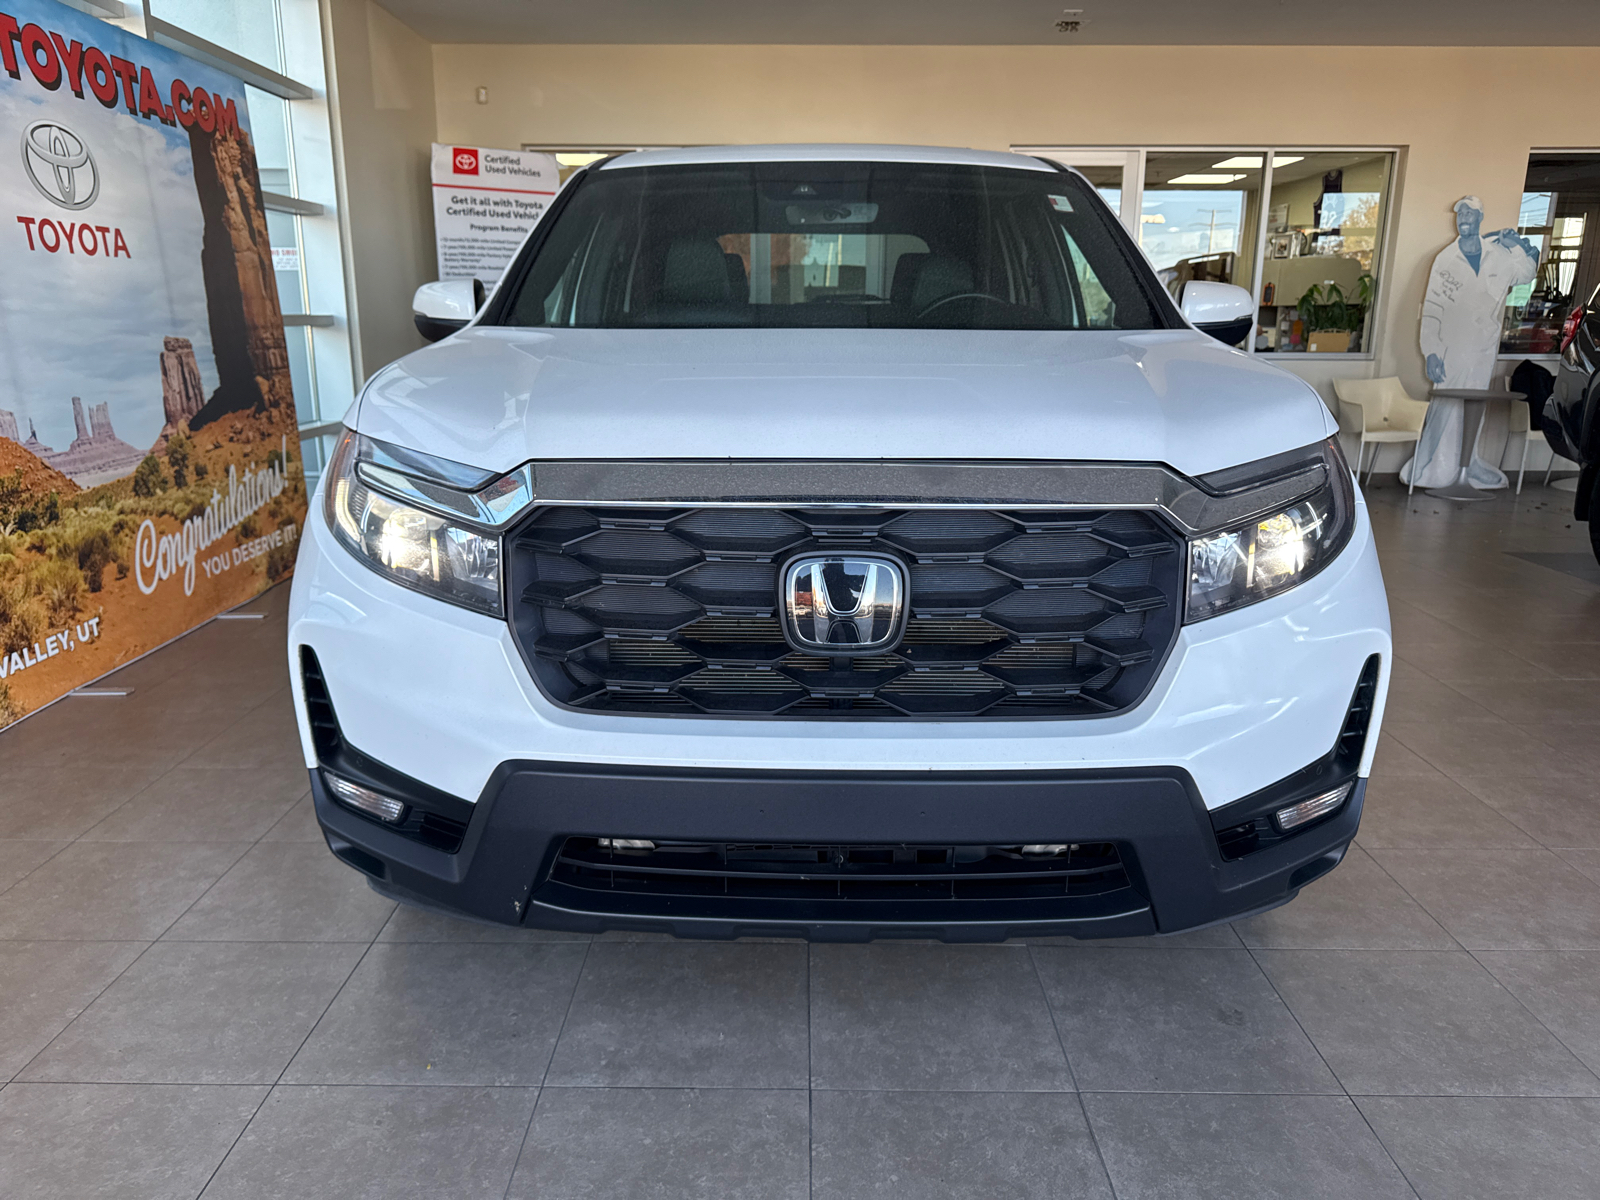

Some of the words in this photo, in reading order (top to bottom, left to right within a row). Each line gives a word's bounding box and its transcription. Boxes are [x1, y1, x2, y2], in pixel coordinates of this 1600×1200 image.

[0, 12, 241, 141] TOYOTA.COM
[484, 154, 521, 166] Certified
[485, 165, 507, 175] Used
[508, 167, 541, 178] Vehicles
[446, 206, 488, 218] Certified
[489, 208, 512, 219] Used
[451, 195, 468, 206] Get
[470, 196, 478, 206] it
[479, 198, 491, 207] all
[492, 198, 513, 208] with
[514, 200, 544, 211] Toyota
[16, 216, 131, 259] TOYOTA
[470, 223, 499, 233] Program
[501, 224, 529, 234] Benefits
[135, 434, 288, 597] Congratulations!
[202, 551, 231, 578] YOU
[231, 530, 283, 566] DESERVE
[283, 523, 298, 544] IT!
[76, 616, 100, 643] UT
